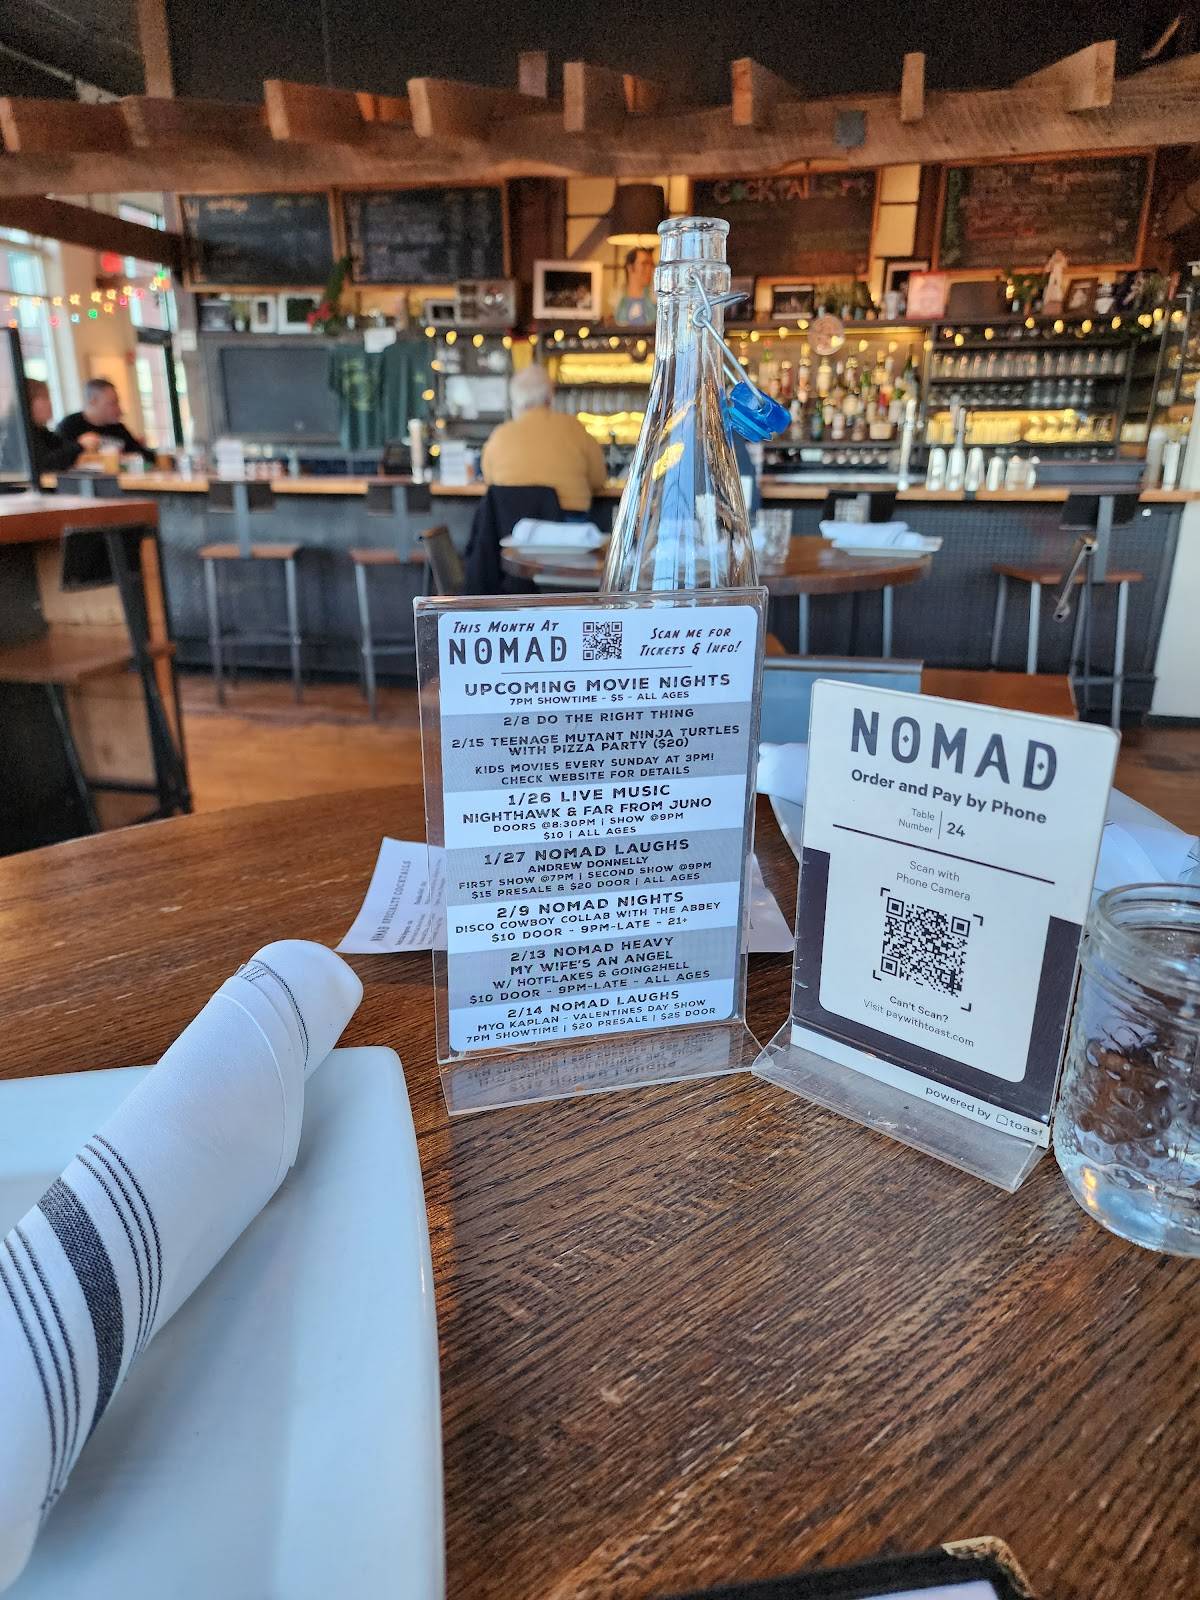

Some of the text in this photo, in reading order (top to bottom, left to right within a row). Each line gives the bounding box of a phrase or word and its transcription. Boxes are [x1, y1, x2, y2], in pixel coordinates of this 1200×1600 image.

[449, 636, 567, 665] NOMAD
[465, 674, 730, 696] UPCOMING MOVIE NIGHTS
[538, 695, 597, 704] SHOWTIME
[611, 693, 623, 702] $5
[662, 691, 690, 699] AGES
[503, 708, 694, 726] 2/8 DO THE RIGHT THING
[452, 725, 740, 749] 2/15 TEENAGE MUTANT NINJA TURTLES
[508, 737, 689, 756] WITH PIZZA PARTY ($20)
[850, 708, 1057, 791] NOMAD
[475, 753, 714, 774] KIDS MOVIES EVERY SUNDAY AT 3PM!
[502, 766, 690, 785] CHECK WEBSITE FOR DETAILS
[508, 785, 670, 805] 1/26 LIVE MUSIC
[851, 769, 1047, 824] Order and Pay by Phone
[463, 798, 712, 824] NIGHTHAWK & FAR FROM JUNO
[494, 813, 684, 832] DOORS @8:30PM SHOW @9PM
[912, 808, 935, 821] Table
[544, 826, 636, 840] $10 ALL AGES
[899, 818, 933, 834] Number
[947, 822, 965, 837] 24
[485, 839, 689, 865] 1/27 NOMAD LAUGHS
[528, 856, 649, 873] ANDREW DONNELLY
[459, 862, 712, 889] FIRST SHOW @7PM SECOND SHOW @9PM
[910, 860, 960, 882] Scan with
[472, 890, 491, 899] $15
[497, 886, 551, 896] PRESALE
[570, 882, 591, 890] $20
[597, 879, 630, 888] DOOR
[644, 876, 664, 884] ALL
[670, 872, 700, 881] AGES
[896, 873, 971, 900] Phone Camera
[456, 902, 721, 933] DISCO COWBOY COLLAB WITH THE ABBEY
[497, 892, 684, 918] 2/9 NOMAD NIGHTS
[492, 933, 515, 943] $10
[523, 928, 562, 939] DOOR
[581, 920, 650, 933] 9PM-LATE
[668, 917, 687, 925] 21+
[511, 937, 674, 961] 2/13 NOMAD HEAVY
[493, 980, 511, 989] W/
[518, 971, 593, 986] HOTFLAKES
[612, 962, 690, 976] GOING2HELL
[511, 950, 673, 975] MY WIFE'S AN ANGEL
[470, 994, 493, 1004] $10
[500, 990, 540, 1000] DOOR
[558, 980, 627, 994] 9PM-LATE
[645, 976, 670, 984] ALL
[676, 970, 710, 981] AGES
[508, 990, 679, 1018] 2/14 NOMAD LAUGHS
[510, 1016, 559, 1028] KAPLAN
[573, 1007, 642, 1020] VALENTINES
[648, 1004, 668, 1012] DAY
[674, 1000, 706, 1009] SHOW
[890, 996, 949, 1023] Can't Scan?
[466, 1008, 716, 1043] 7PM SHOWTIME $20 PRESALE $25 DOOR
[864, 999, 974, 1047] Visit paywithtoast.com
[926, 1087, 974, 1112] powered
[978, 1107, 991, 1120] by
